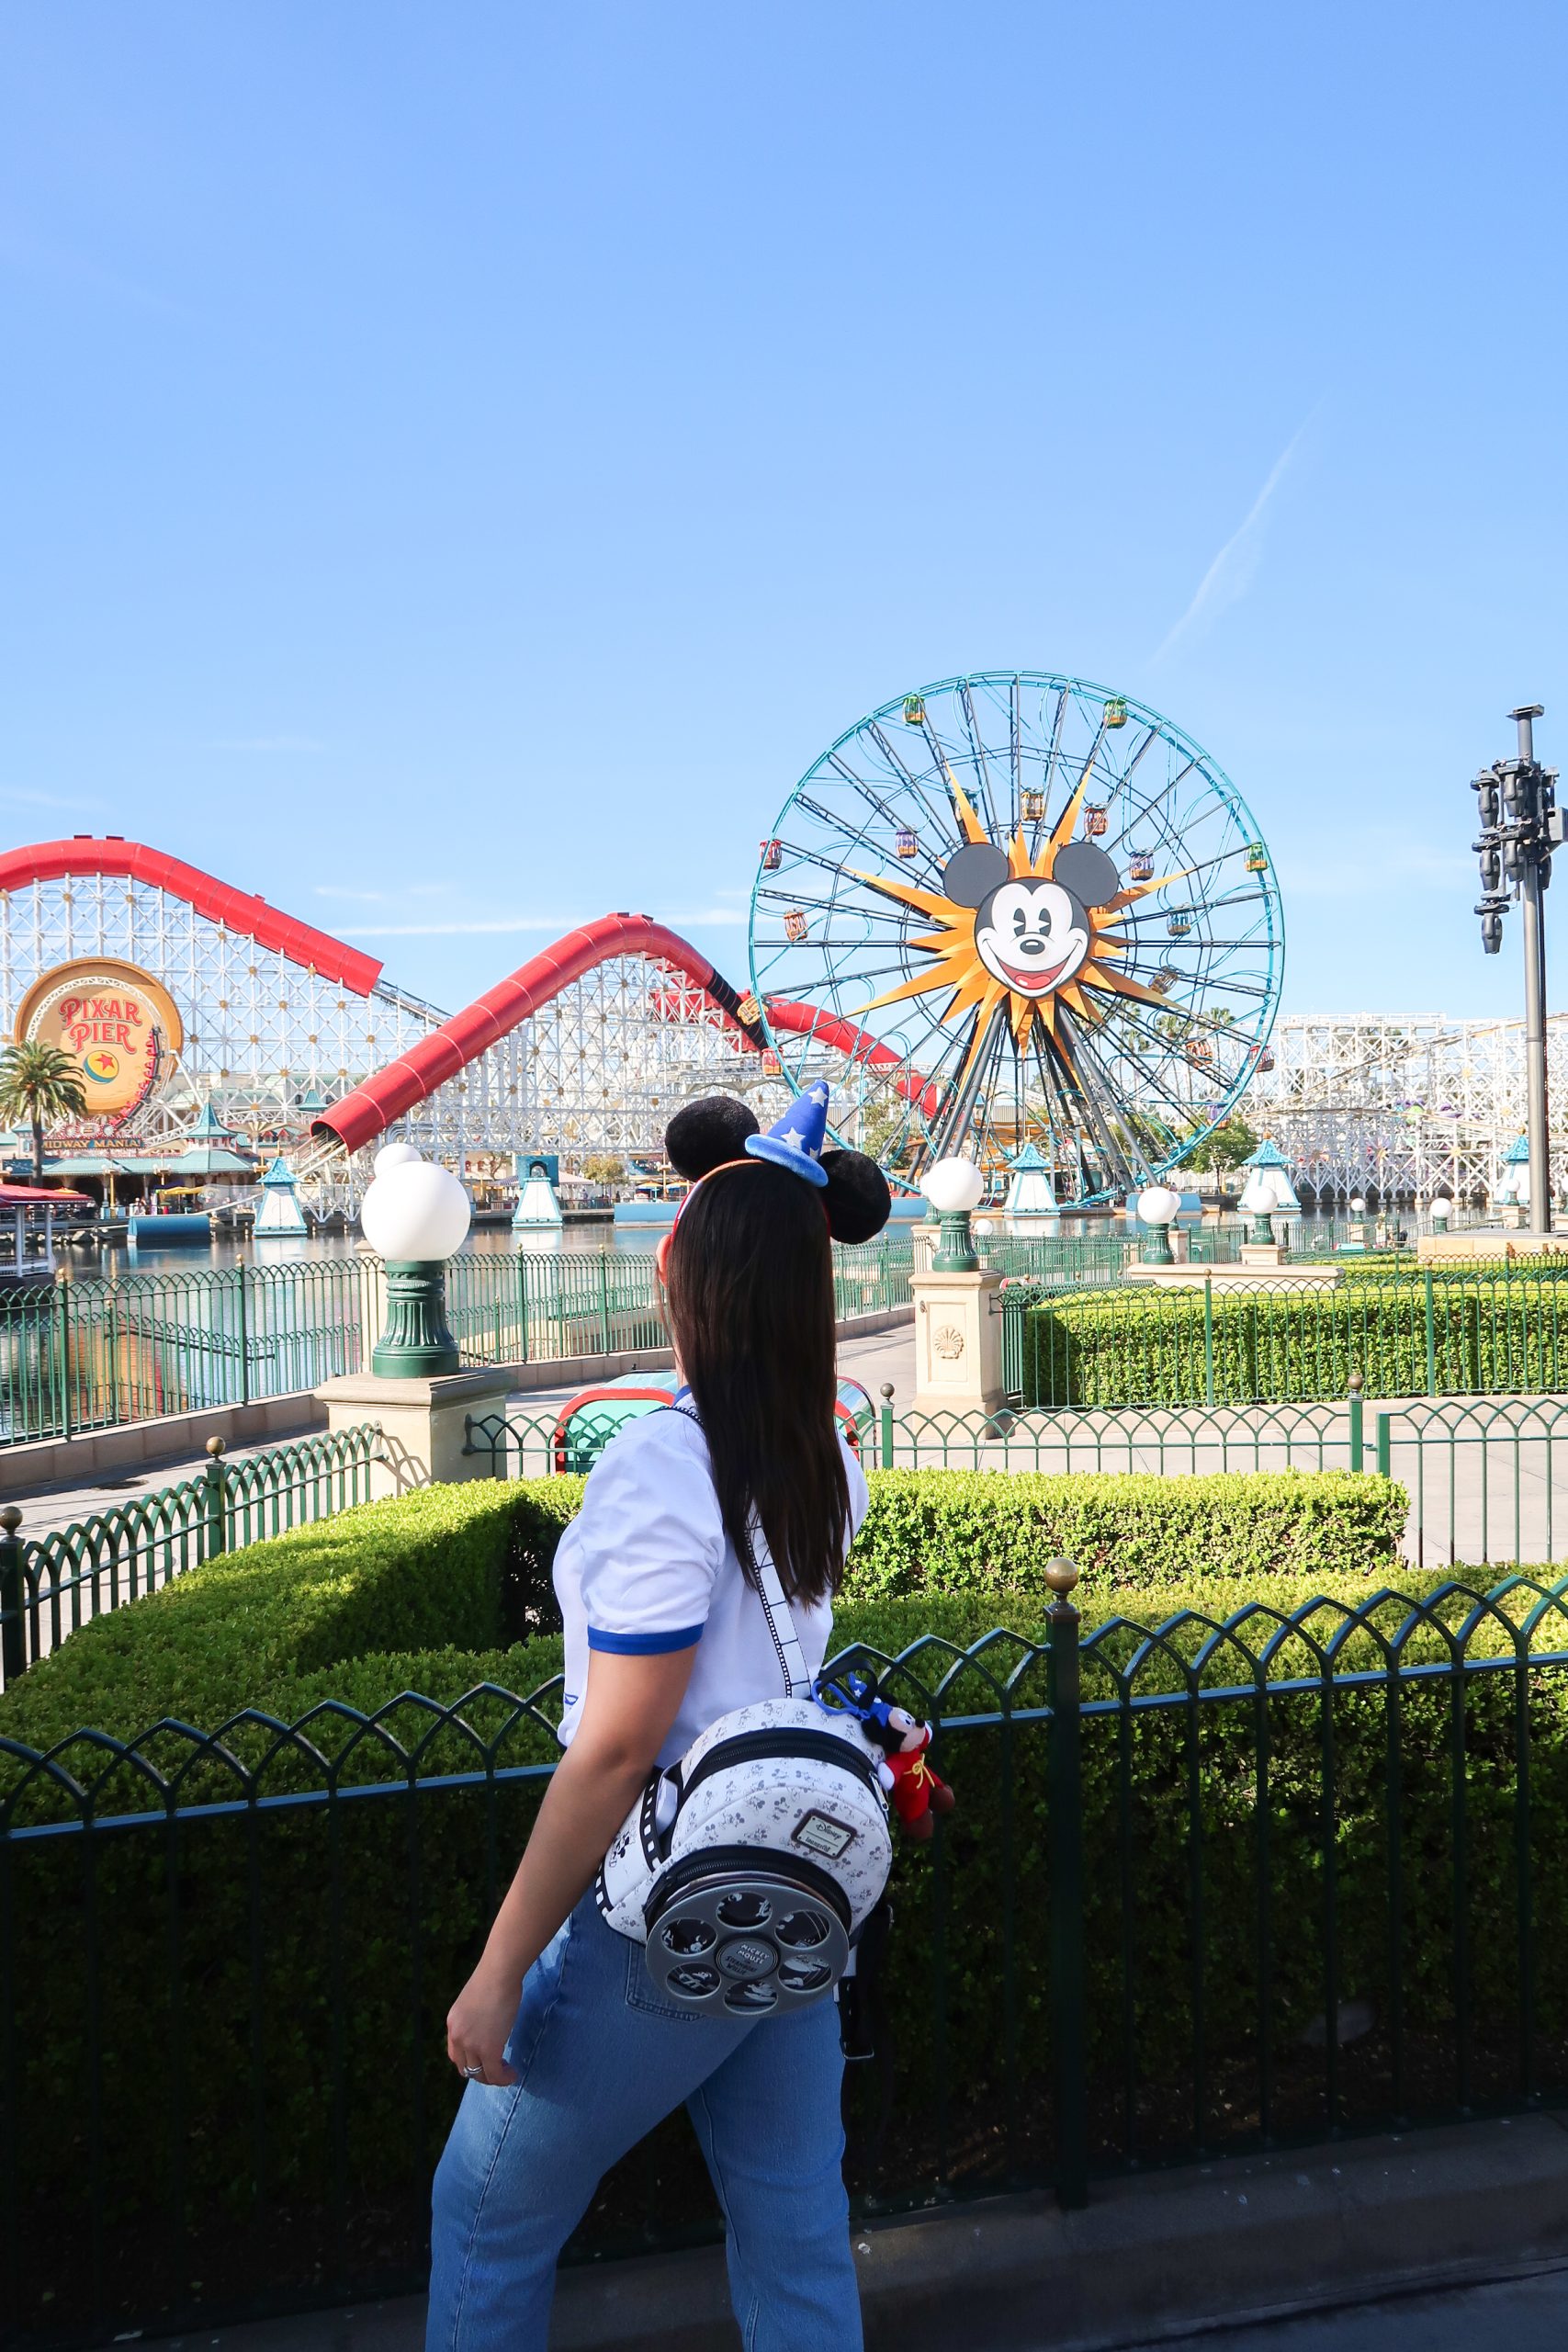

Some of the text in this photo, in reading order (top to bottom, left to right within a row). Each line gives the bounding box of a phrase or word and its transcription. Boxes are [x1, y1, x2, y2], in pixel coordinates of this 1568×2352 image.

[59, 996, 142, 1030] PIXAR
[69, 1022, 137, 1055] PIER
[816, 1820, 842, 1840] Disney
[737, 1950, 764, 1964] MOUSE
[740, 1944, 770, 1959] MICKEY
